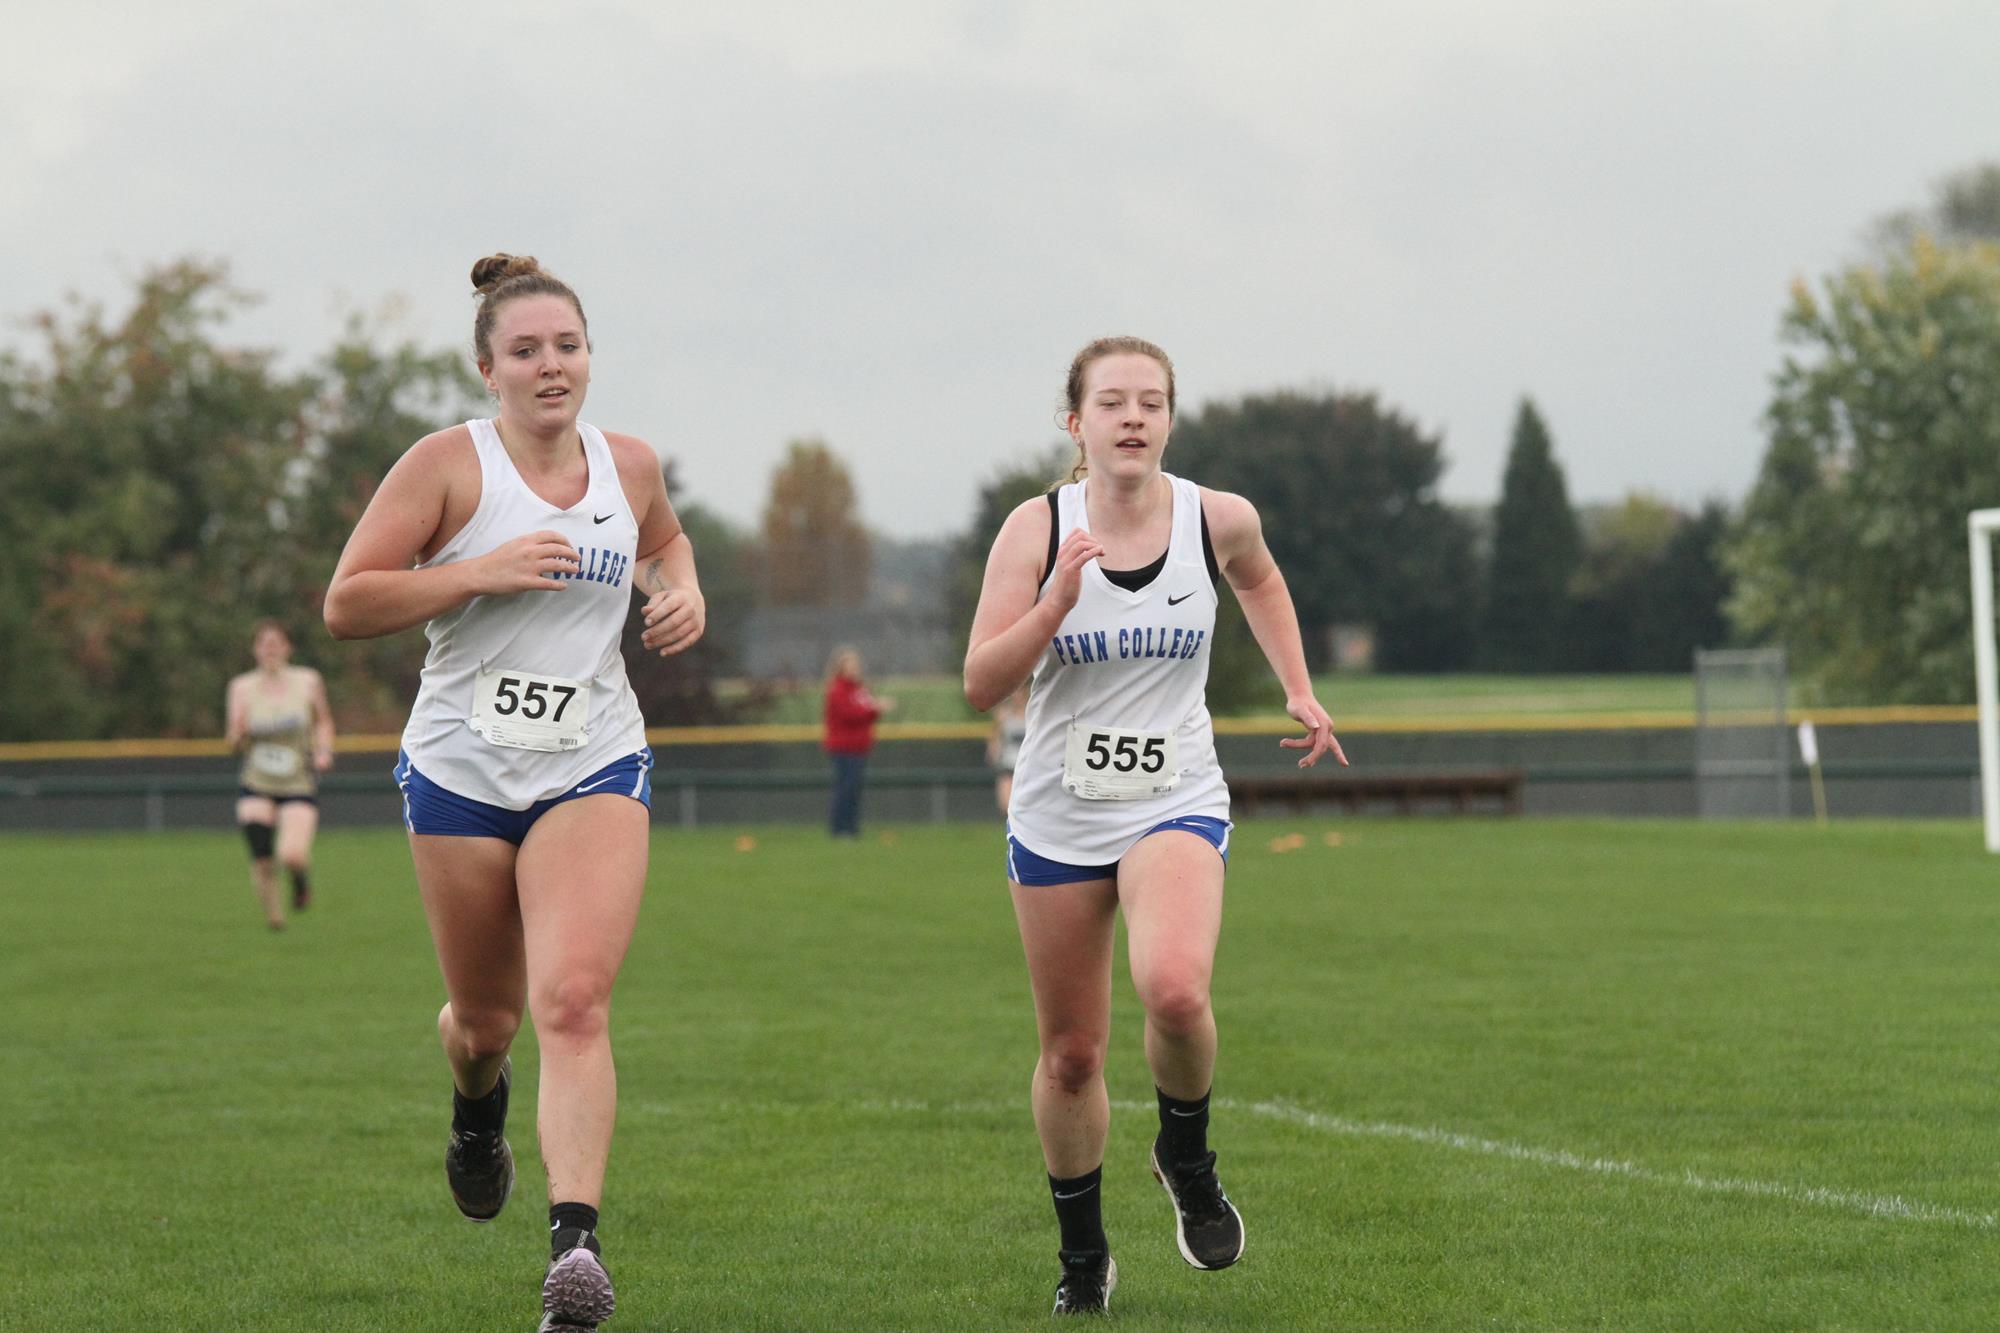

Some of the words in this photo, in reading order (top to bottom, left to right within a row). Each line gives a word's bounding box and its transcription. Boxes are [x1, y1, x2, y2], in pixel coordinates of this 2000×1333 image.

[1053, 631, 1108, 665] PENN
[1119, 627, 1204, 659] COLLEGE
[494, 677, 576, 722] 557
[1085, 733, 1165, 773] 555
